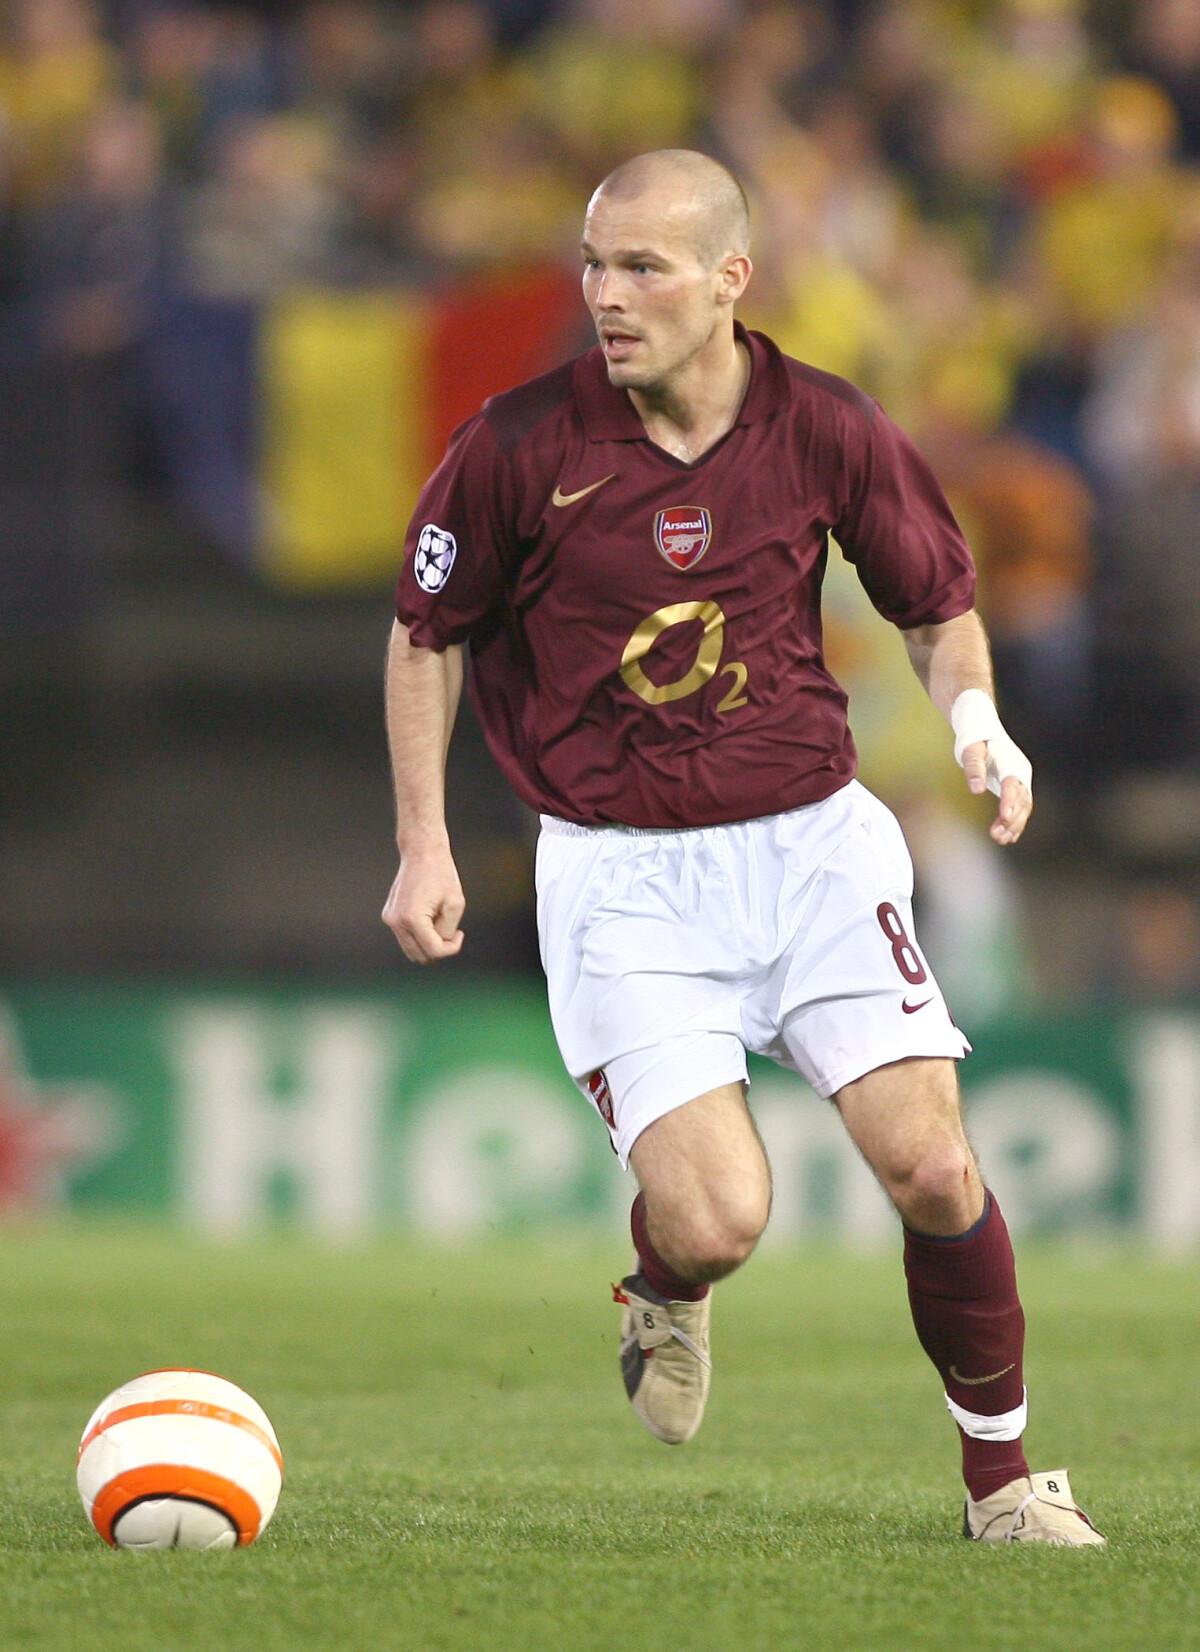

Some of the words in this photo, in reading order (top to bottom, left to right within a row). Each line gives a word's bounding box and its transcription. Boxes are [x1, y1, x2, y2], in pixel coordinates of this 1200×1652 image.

[663, 519, 702, 530] Arsenal
[876, 901, 927, 985] 8
[643, 1312, 655, 1329] 8
[1047, 1480, 1060, 1493] 8
